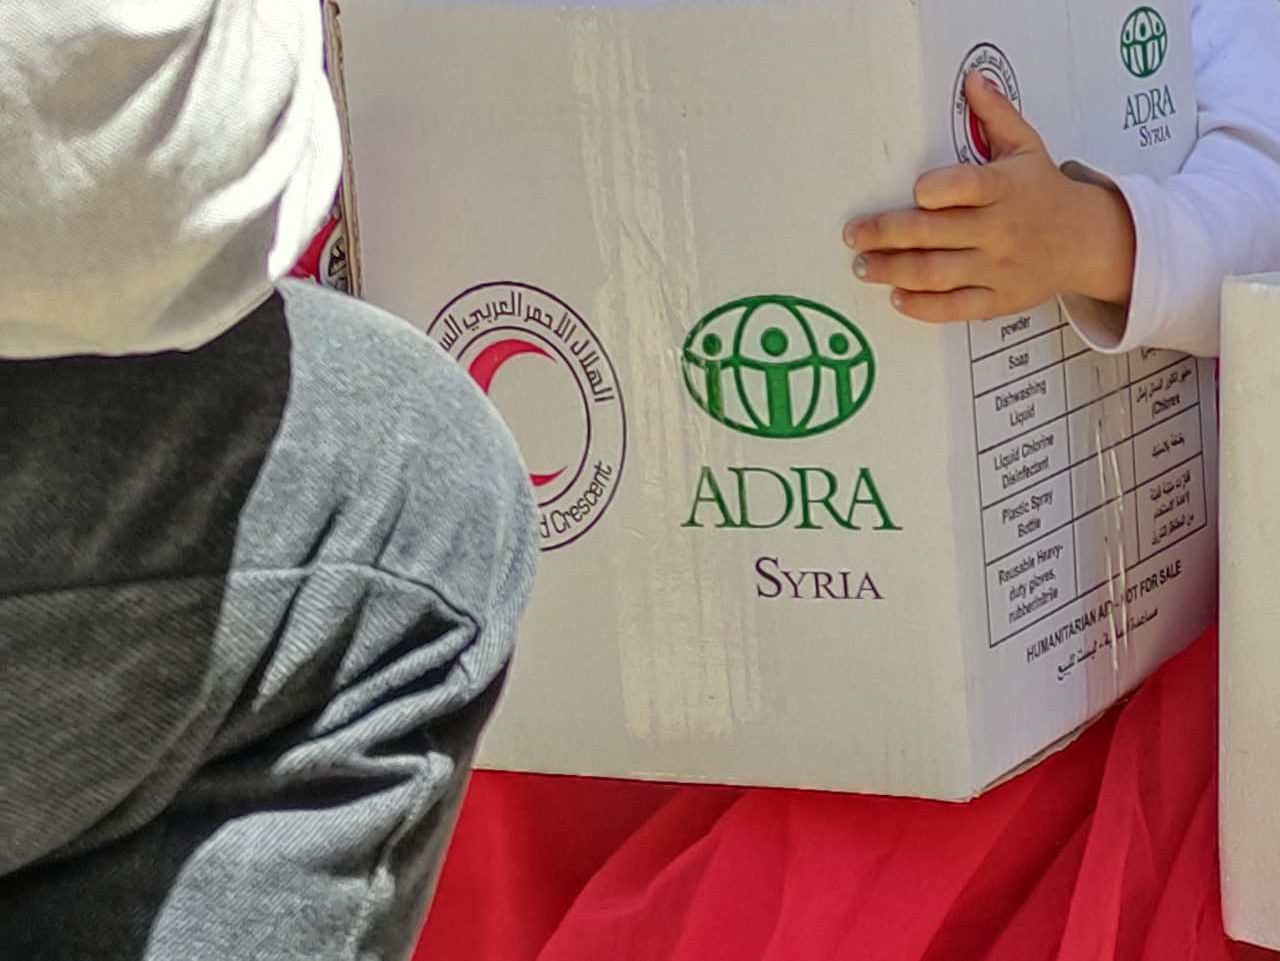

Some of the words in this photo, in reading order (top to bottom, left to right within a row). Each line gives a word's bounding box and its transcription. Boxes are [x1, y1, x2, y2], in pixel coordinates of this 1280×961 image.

[1123, 84, 1176, 130] ADRA
[462, 291, 522, 332] العربي
[1001, 316, 1031, 341] powder
[571, 337, 615, 403] الهلال
[1008, 352, 1030, 370] Soap
[995, 380, 1047, 412] Dishwashing
[1010, 403, 1035, 427] Liquid
[994, 447, 1020, 471] Liquid
[1022, 435, 1054, 458] Chlorine
[1002, 455, 1050, 490] Disinfectant
[550, 460, 612, 534] Crescent
[681, 466, 903, 531] ADRA
[1002, 501, 1030, 525] Plastic
[1031, 490, 1054, 511] Spray
[1009, 582, 1028, 601] duty
[1026, 609, 1097, 663] HUMANITARIAN
[1140, 574, 1158, 598] FOR
[1159, 559, 1182, 585] SALE
